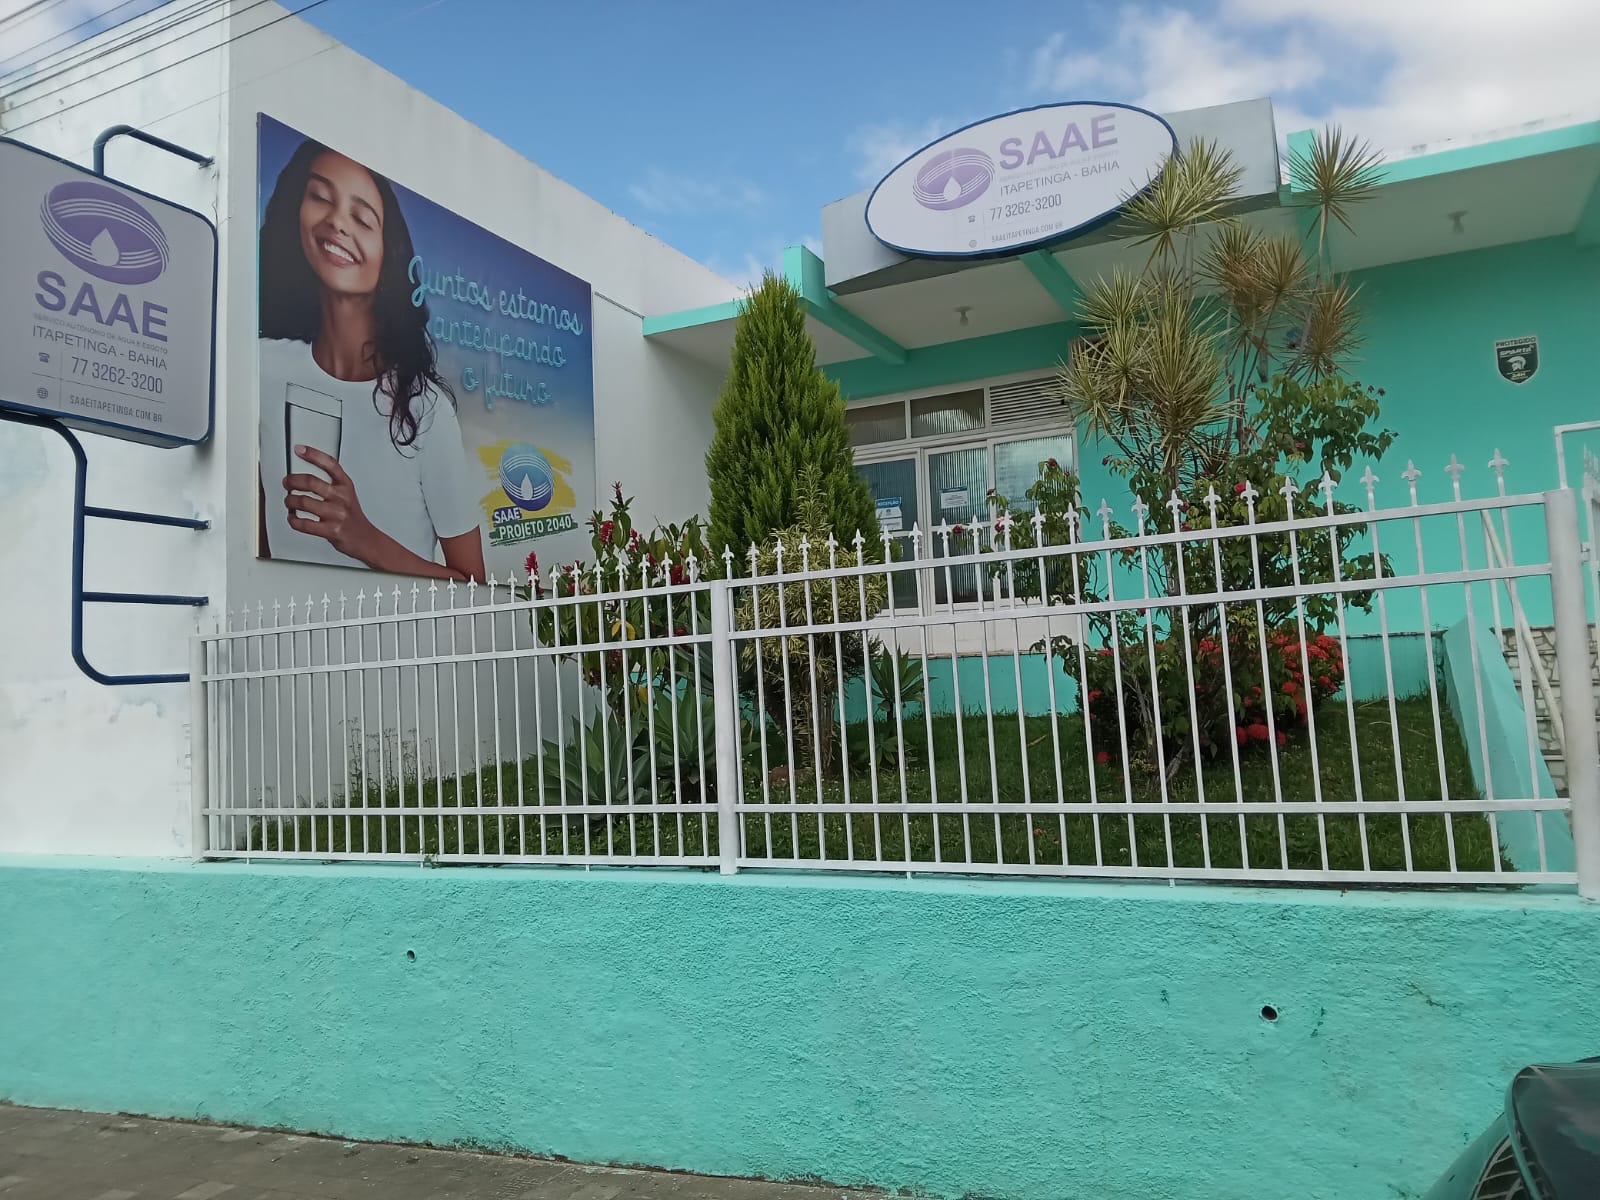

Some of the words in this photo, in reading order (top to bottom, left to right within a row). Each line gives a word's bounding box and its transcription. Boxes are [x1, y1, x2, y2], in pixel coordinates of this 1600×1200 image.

[1000, 112, 1118, 170] SAAE
[1000, 171, 1072, 196] ITAPETINGA
[1081, 160, 1120, 177] BAHIA
[990, 206, 1003, 221] 77
[1005, 193, 1062, 218] 3262-3200
[35, 271, 168, 342] SAAE
[408, 255, 495, 311] Juntos
[499, 287, 584, 336] estamos
[33, 325, 117, 357] ITAPETINGA
[128, 350, 168, 370] BAHIA
[432, 315, 566, 368] antecipando
[71, 356, 89, 376] 77
[91, 362, 163, 394] 3262-3200
[483, 360, 552, 410] futuro
[493, 507, 521, 524] SAAE
[499, 521, 544, 540] PROJETO
[547, 515, 572, 532] 2040
